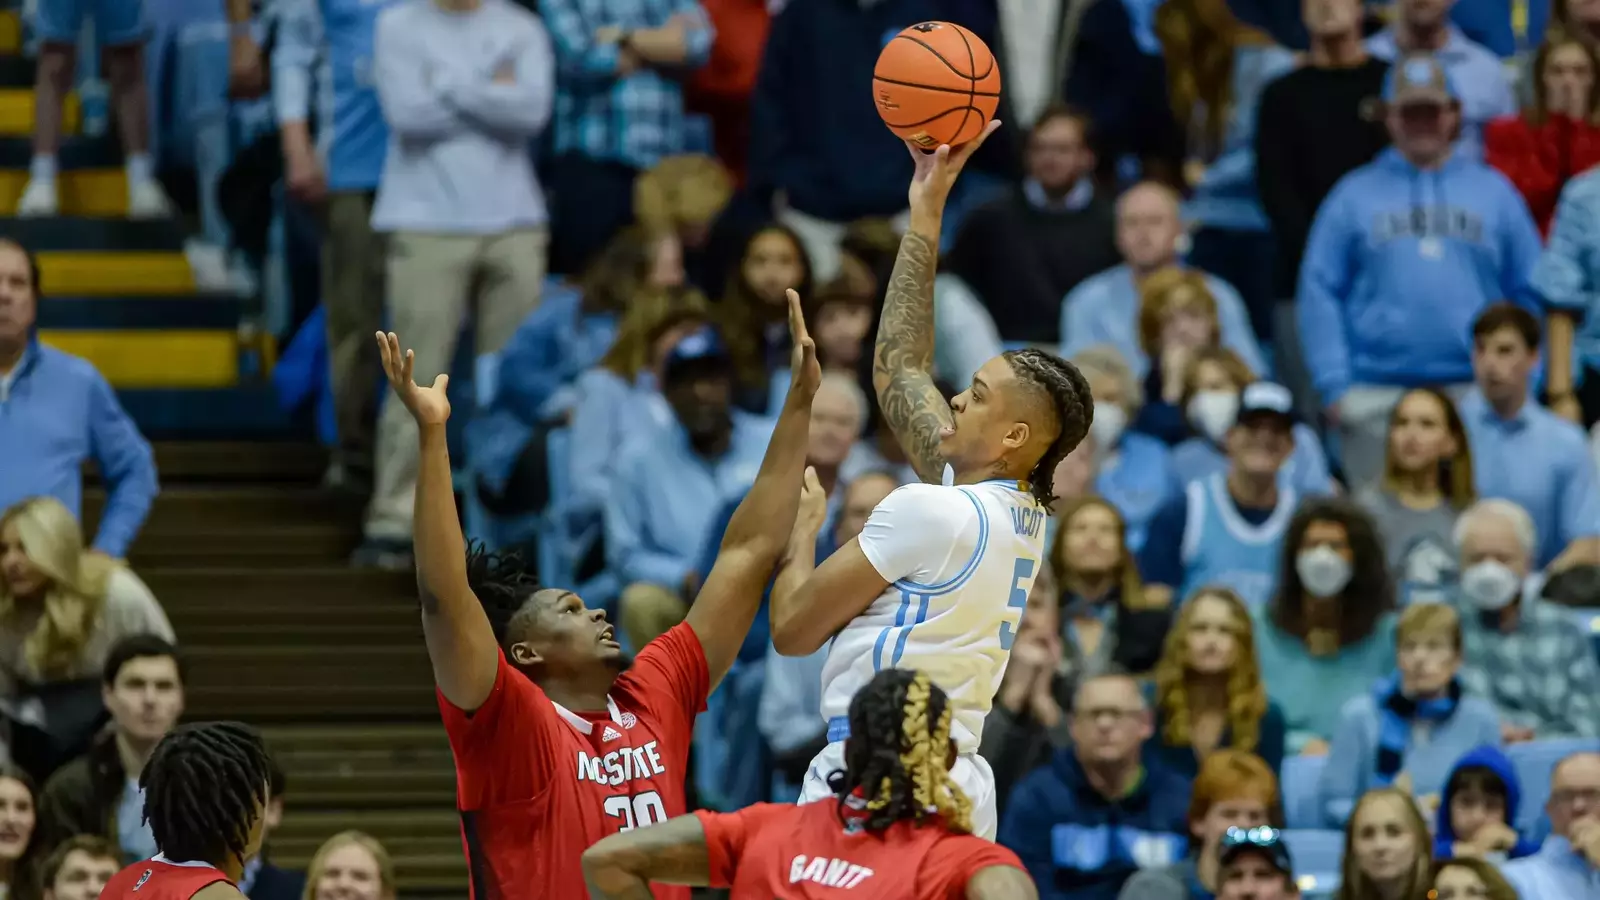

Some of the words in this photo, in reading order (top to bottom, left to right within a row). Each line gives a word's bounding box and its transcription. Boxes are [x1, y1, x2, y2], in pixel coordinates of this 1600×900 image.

[999, 557, 1035, 651] 5
[603, 790, 668, 833] 30
[789, 854, 874, 889] GANTT
